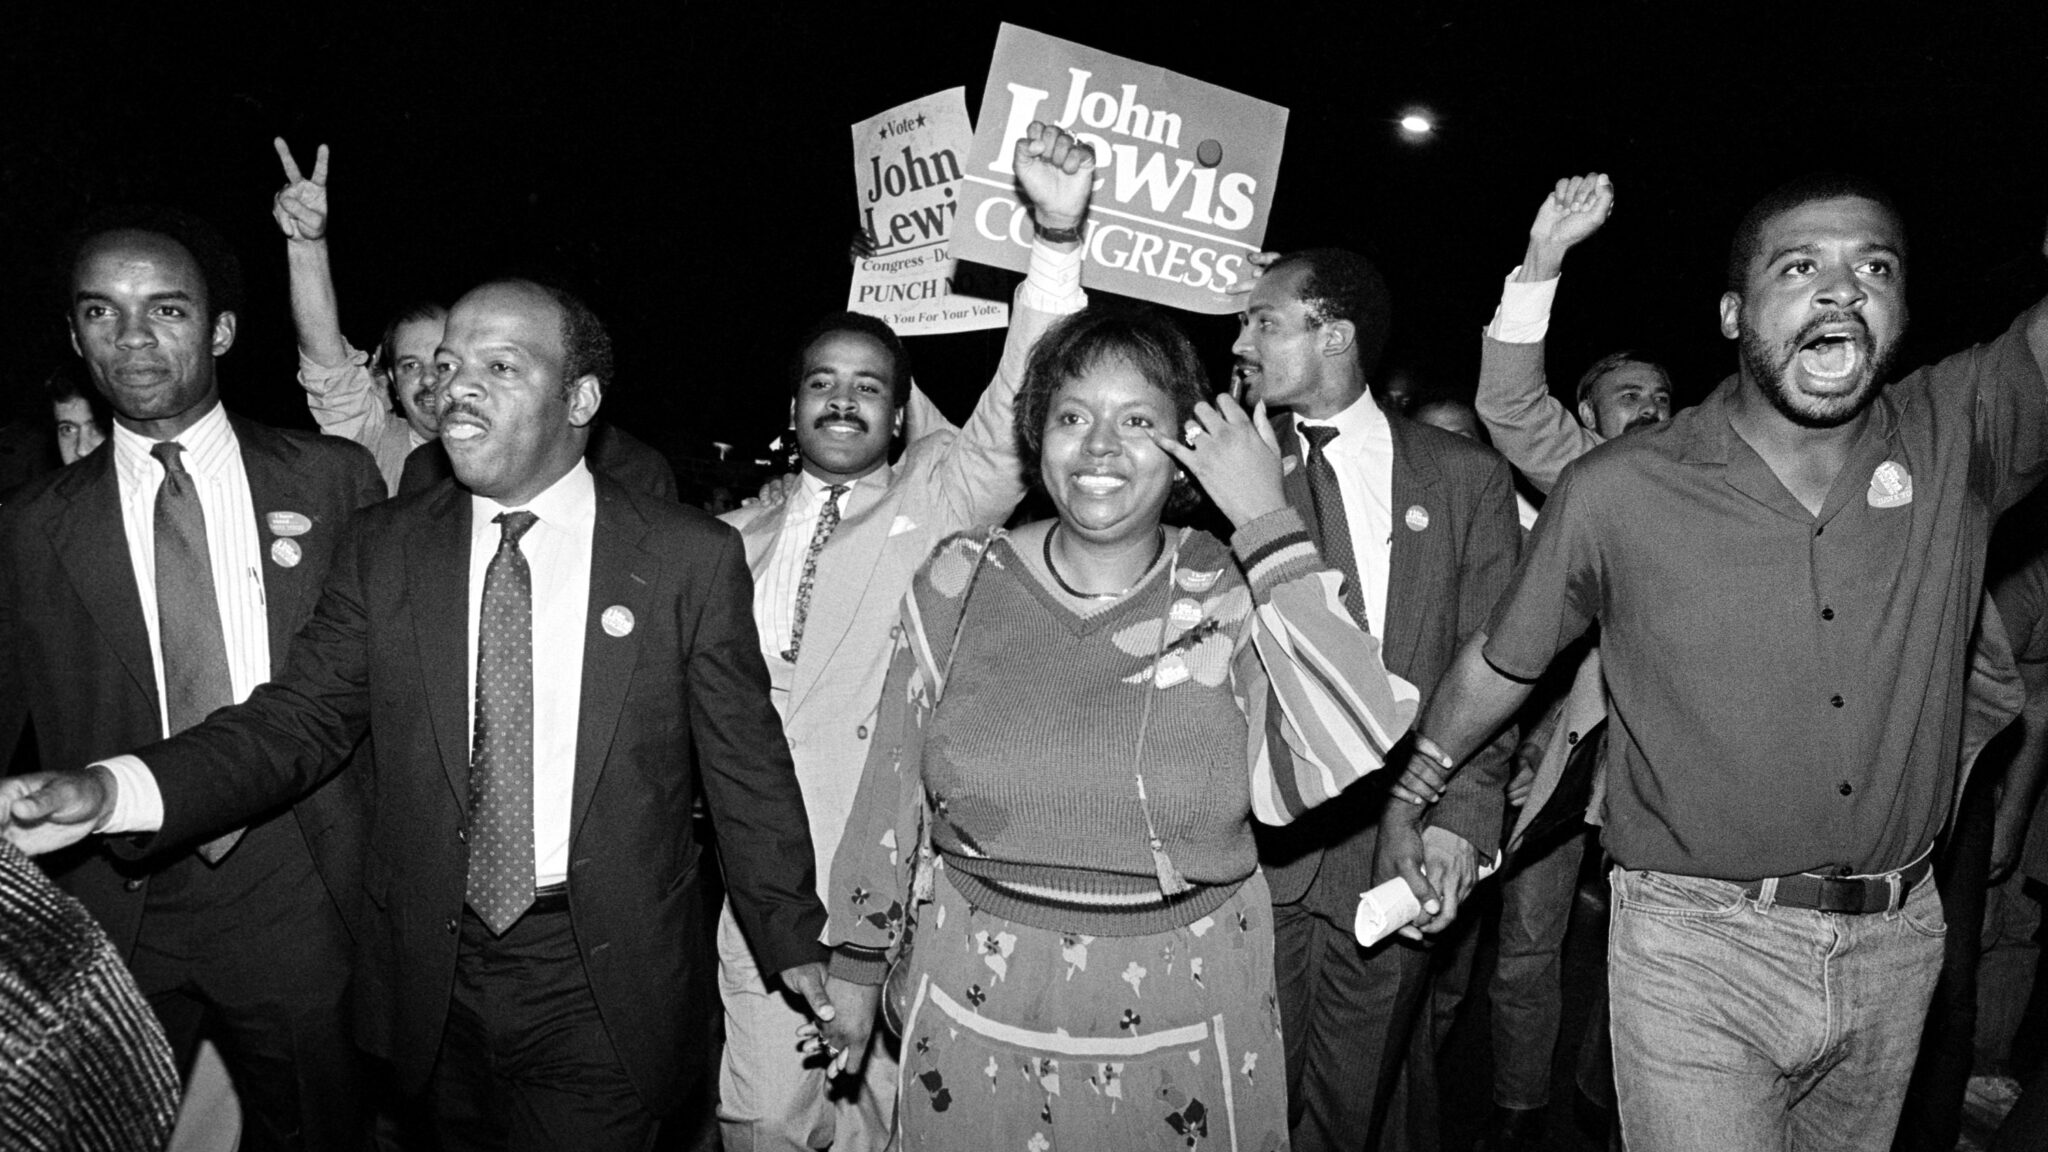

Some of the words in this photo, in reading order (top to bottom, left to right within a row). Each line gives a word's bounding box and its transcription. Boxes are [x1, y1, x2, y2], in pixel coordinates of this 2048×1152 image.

[1054, 67, 1183, 149] John
[887, 118, 916, 138] Vote
[868, 145, 965, 203] John
[859, 278, 938, 303] PUNCH
[893, 314, 916, 325] You
[918, 311, 938, 323] For
[942, 308, 969, 321] Your
[972, 304, 1001, 317] Vote.
